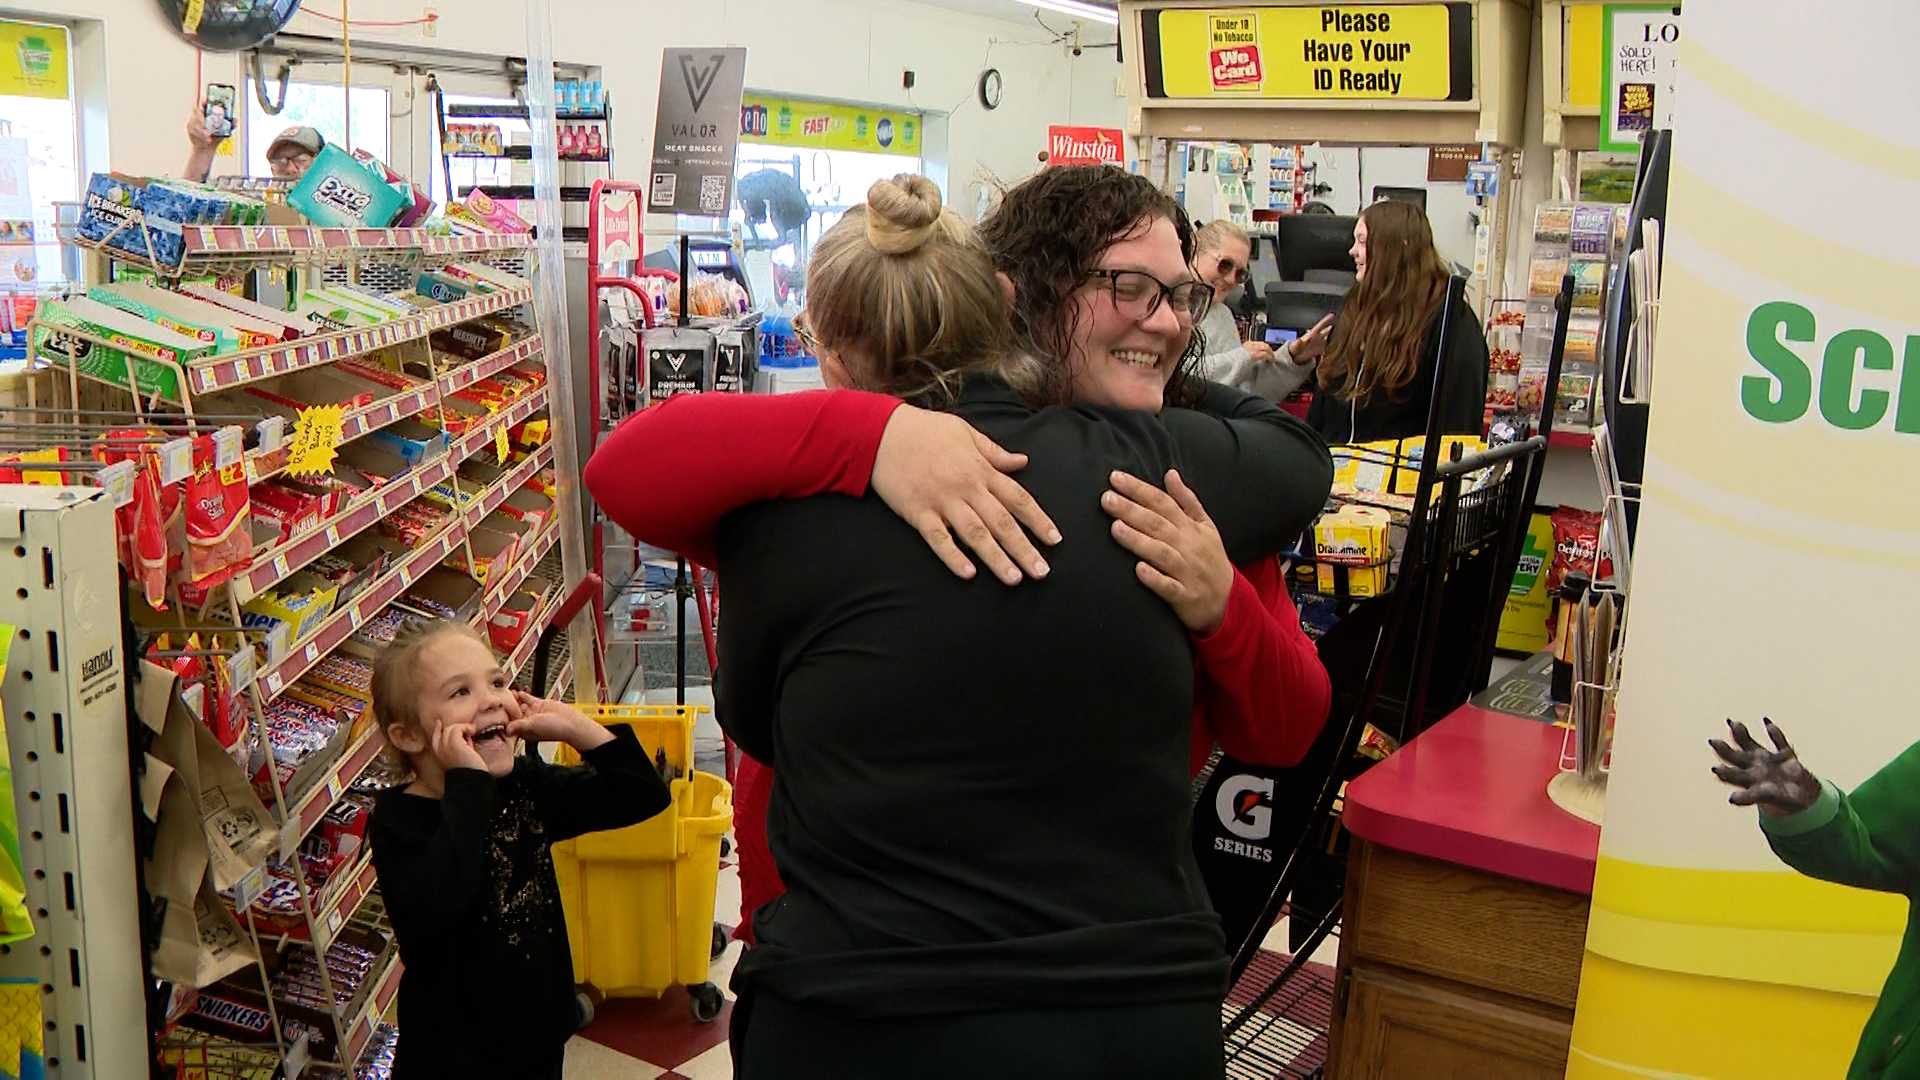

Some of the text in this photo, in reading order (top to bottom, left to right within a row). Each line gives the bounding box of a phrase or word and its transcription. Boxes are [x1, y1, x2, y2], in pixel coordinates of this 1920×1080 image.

[1216, 19, 1239, 30] Under
[1321, 9, 1390, 32] Please
[1213, 32, 1253, 42] No Tobacco
[1219, 51, 1250, 66] We
[1304, 39, 1411, 62] Have Your
[1620, 47, 1651, 58] SOLD
[1214, 62, 1258, 80] Card
[1620, 56, 1656, 75] HERE!
[1314, 68, 1402, 94] ID Ready
[672, 124, 717, 138] VALOR
[804, 117, 830, 134] FAST
[664, 143, 723, 153] MEAT SNACKS
[1053, 135, 1117, 160] Winston
[88, 193, 143, 223] ICE BREAKERS
[91, 210, 106, 220] ICE
[1214, 837, 1273, 863] SERIES
[199, 994, 272, 1031] SNICKERS
